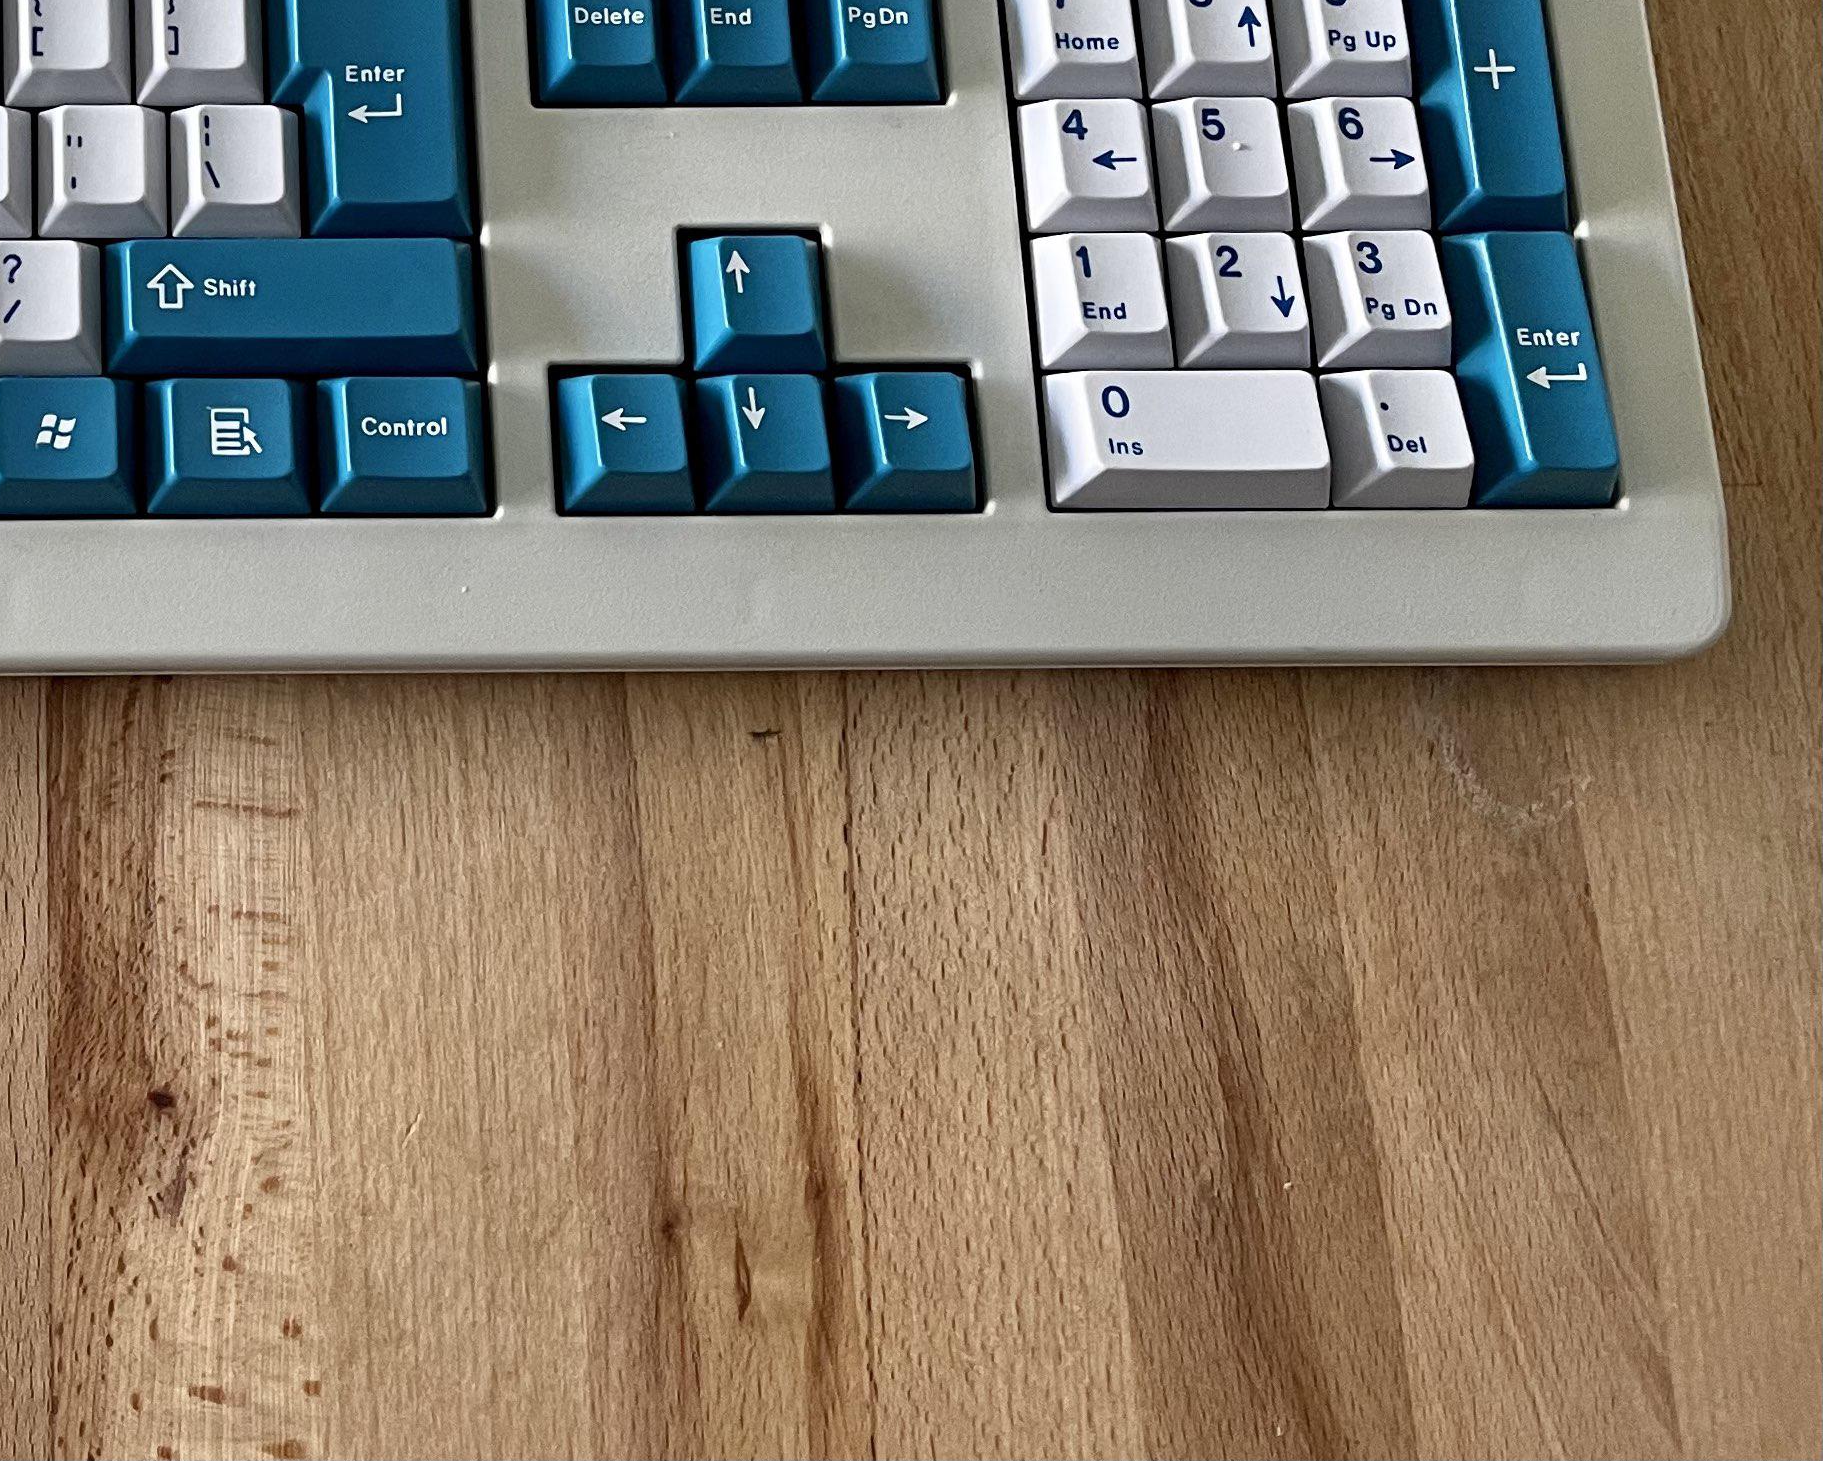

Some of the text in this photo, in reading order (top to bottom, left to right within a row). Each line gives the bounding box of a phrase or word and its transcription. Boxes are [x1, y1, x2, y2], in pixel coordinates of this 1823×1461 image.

[575, 7, 644, 24] Delete
[711, 8, 751, 24] End
[32, 26, 43, 56] [
[168, 26, 179, 55] ]
[1055, 33, 1119, 49] Home
[1328, 30, 1395, 51] Pg Up
[346, 65, 404, 82] Enter
[1474, 49, 1515, 89] +
[1062, 109, 1088, 140] 4
[1202, 109, 1225, 141] 5
[1338, 107, 1363, 140] 6
[3, 254, 22, 283] ?
[1076, 246, 1091, 278] 1
[1216, 246, 1242, 277] 2
[1357, 242, 1382, 274] 3
[204, 279, 255, 296] Shift
[4, 300, 21, 323] /
[1082, 302, 1126, 319] End
[1365, 297, 1437, 320] Pg Dn
[1517, 328, 1580, 346] Enter
[1102, 386, 1129, 418] 0
[362, 417, 446, 436] Control
[1109, 438, 1143, 455] Ins
[1387, 435, 1427, 453] Del
